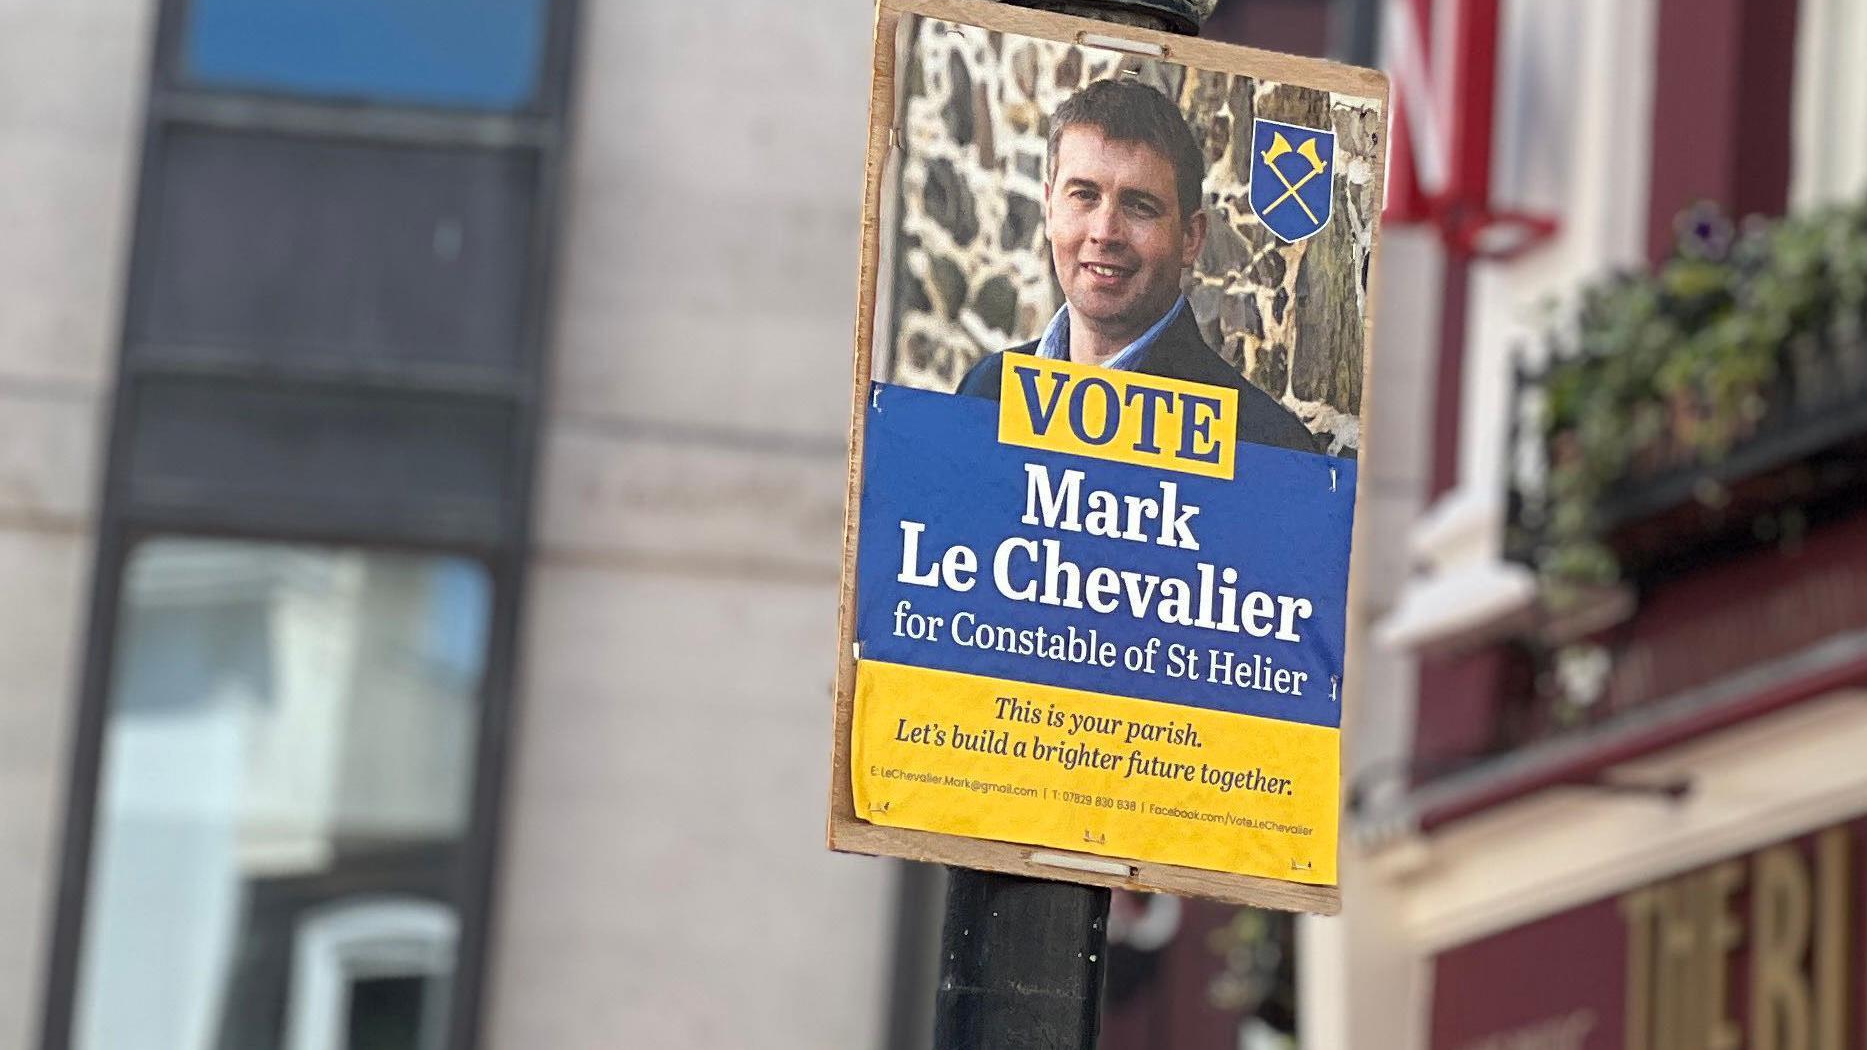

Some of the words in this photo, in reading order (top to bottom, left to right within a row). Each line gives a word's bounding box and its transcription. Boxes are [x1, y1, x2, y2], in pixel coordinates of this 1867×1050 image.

[1013, 365, 1222, 464] VOTE
[1021, 463, 1200, 551] Mark
[897, 520, 978, 592] Le
[993, 536, 1313, 643] Chevalier
[892, 601, 944, 642] for
[951, 611, 1117, 668] Constable
[1124, 638, 1161, 674] of
[1167, 644, 1200, 681] St
[1208, 649, 1308, 696] Helier
[895, 718, 946, 748] Let’s
[952, 723, 1008, 756] build
[1013, 738, 1027, 758] a
[1032, 736, 1123, 773] brighter
[1124, 750, 1195, 780] future
[1200, 763, 1294, 796] together.
[995, 696, 1041, 724] This
[1047, 704, 1065, 728] is
[1068, 712, 1122, 736] your
[1124, 718, 1203, 749] parish.
[1053, 787, 1061, 799] T:
[1618, 855, 1742, 1050] THE
